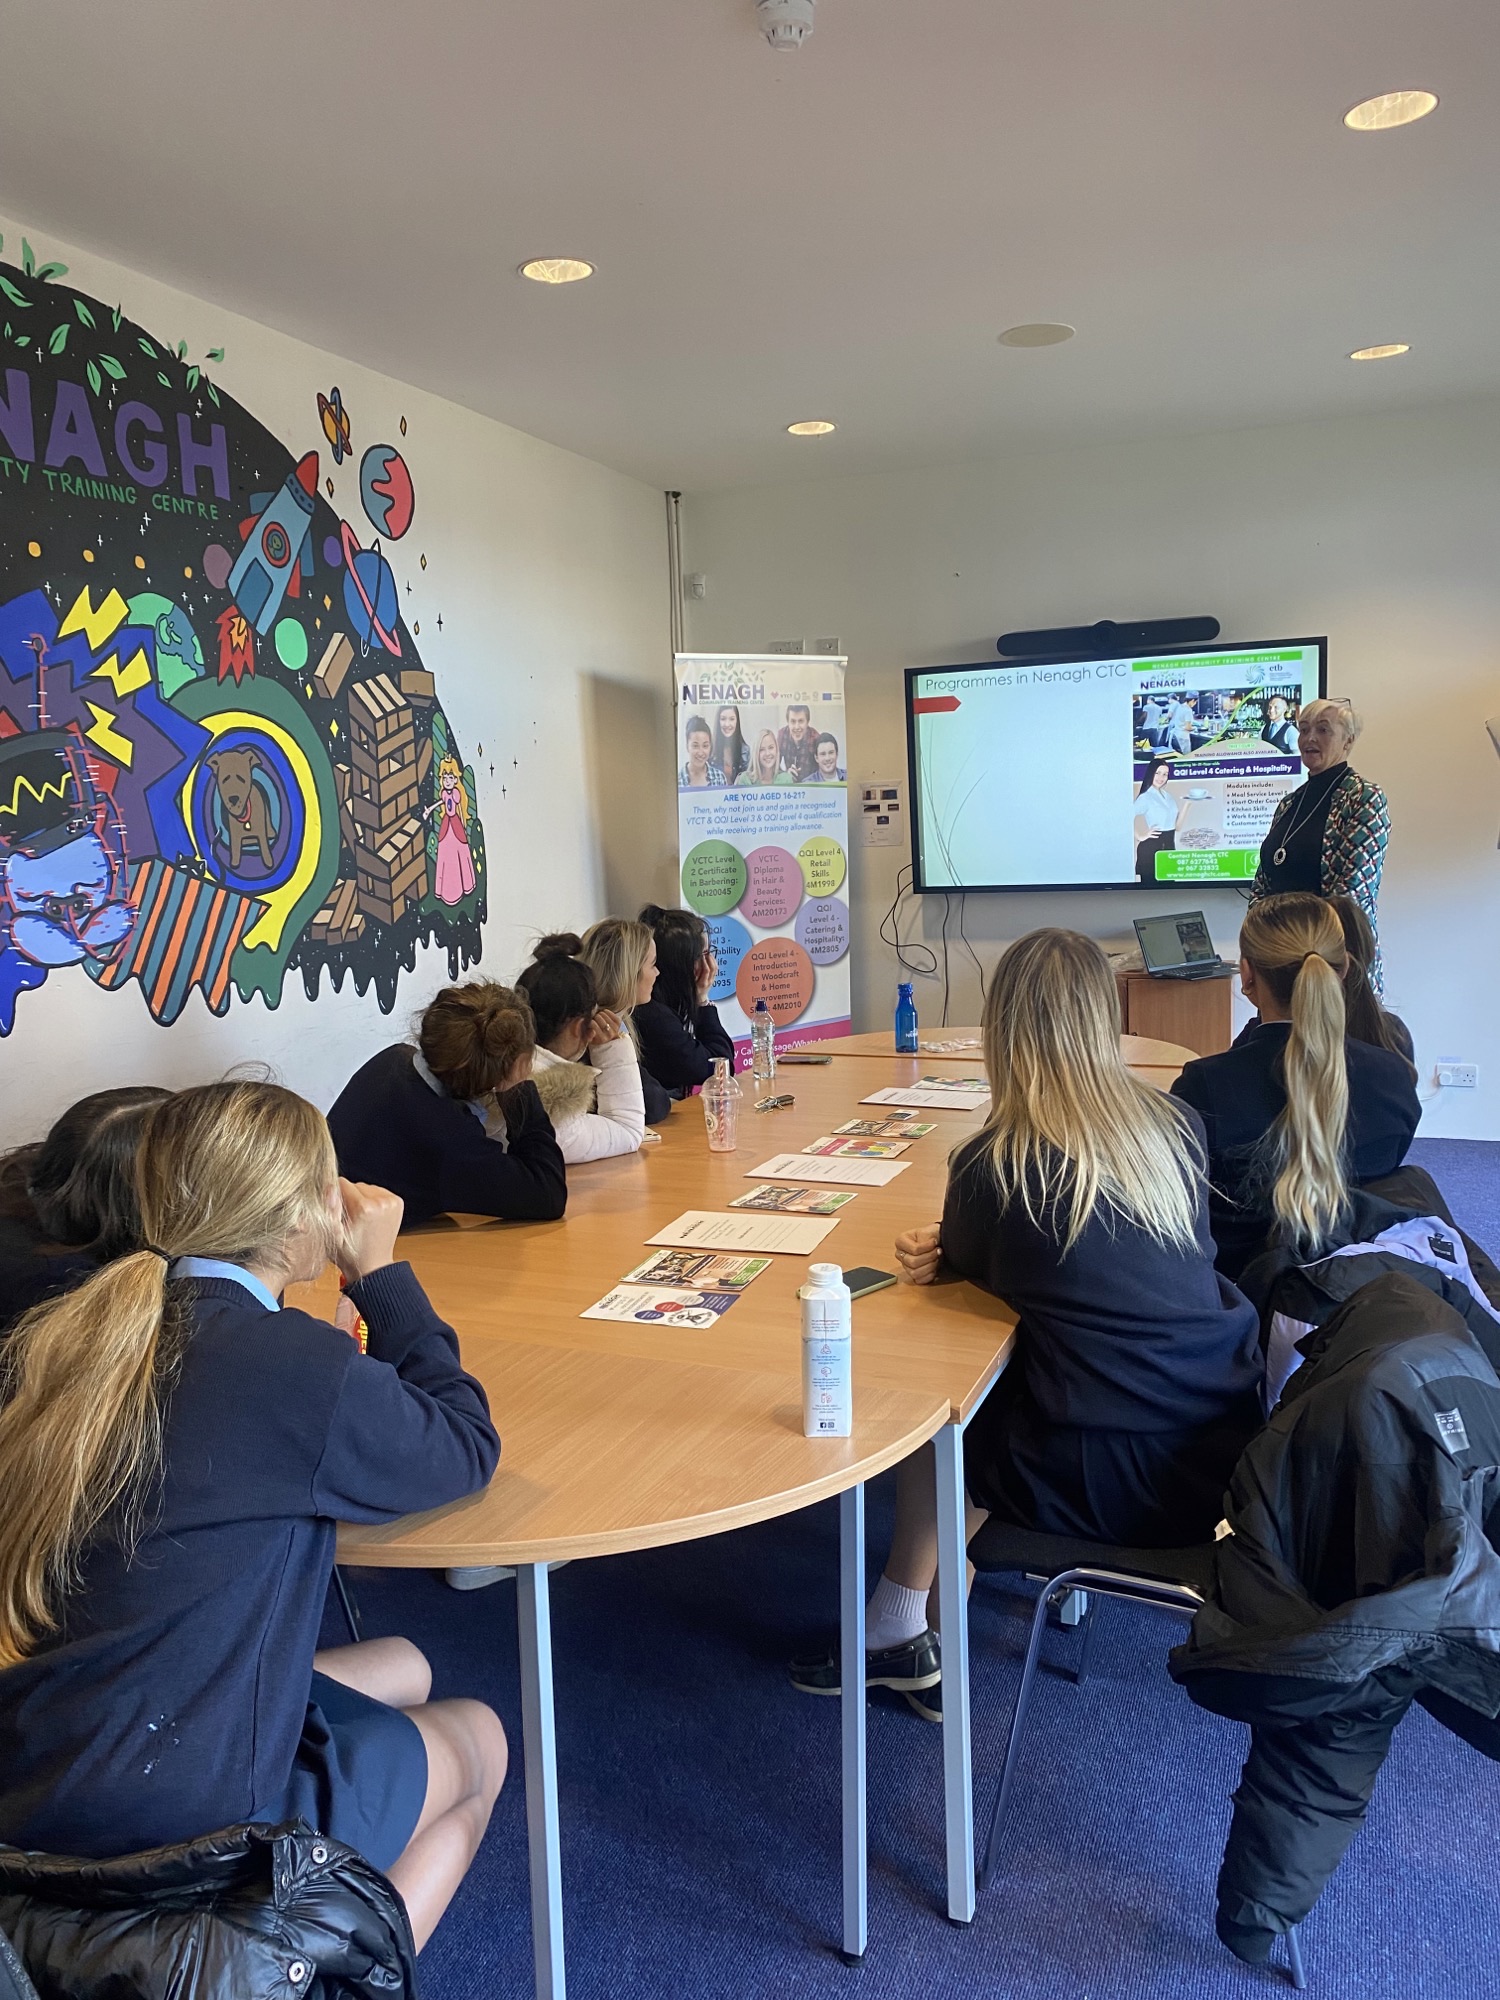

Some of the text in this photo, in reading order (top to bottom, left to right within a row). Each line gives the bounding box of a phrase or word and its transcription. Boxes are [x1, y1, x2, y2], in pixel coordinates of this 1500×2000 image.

[42, 469, 138, 505] TRAINING
[152, 493, 219, 520] CENTRE
[926, 664, 1127, 691] Programmes in Nenagh CTC
[1140, 679, 1185, 690] NENAGH
[683, 684, 765, 705] NENAGH
[1189, 767, 1207, 775] Level
[1208, 767, 1214, 775] 4
[1214, 766, 1244, 776] Catering
[1245, 765, 1252, 773] &
[1253, 764, 1292, 774] Hospitality
[741, 793, 758, 801] YOU
[760, 792, 781, 800] AGED
[783, 791, 806, 799] 16-21?
[713, 806, 727, 815] why
[742, 805, 755, 814] join
[765, 803, 778, 811] and
[779, 803, 793, 812] gain
[800, 801, 836, 811] recognised
[686, 816, 705, 825] VTCT
[714, 815, 728, 824] QQI
[730, 815, 749, 823] Level
[751, 814, 755, 822] 3
[763, 813, 779, 822] QQI
[780, 812, 797, 820] Level
[803, 811, 842, 820] qualification
[706, 826, 723, 835] while
[725, 824, 757, 835] receiving
[764, 824, 789, 833] training
[799, 849, 814, 858] QQI
[815, 848, 835, 857] Level
[1191, 852, 1216, 860] Nenagh
[692, 854, 735, 865] VCTC Level
[758, 854, 779, 863] VCTC
[810, 859, 831, 867] Retail
[691, 866, 737, 876] 2 Certificate
[754, 866, 784, 875] Diploma
[811, 870, 829, 878] Skills
[699, 877, 738, 887] Barbering:
[762, 876, 777, 884] Hair
[779, 875, 785, 883] &
[697, 888, 732, 897] AH20045
[756, 887, 782, 896] Beauty
[753, 898, 786, 906] Services:
[816, 904, 832, 913] QQI
[809, 915, 829, 924] Level
[805, 926, 836, 934] Catering
[804, 935, 845, 945] Hospitality:
[717, 946, 741, 956] ability
[810, 945, 839, 954] 4M2805
[751, 953, 767, 961] QQI
[769, 950, 788, 959] Level
[753, 960, 798, 971] Introduction
[761, 970, 799, 981] Woodcraft
[761, 983, 791, 991] & Home
[752, 992, 800, 1003] Improvement
[772, 1001, 802, 1011] 4M2010
